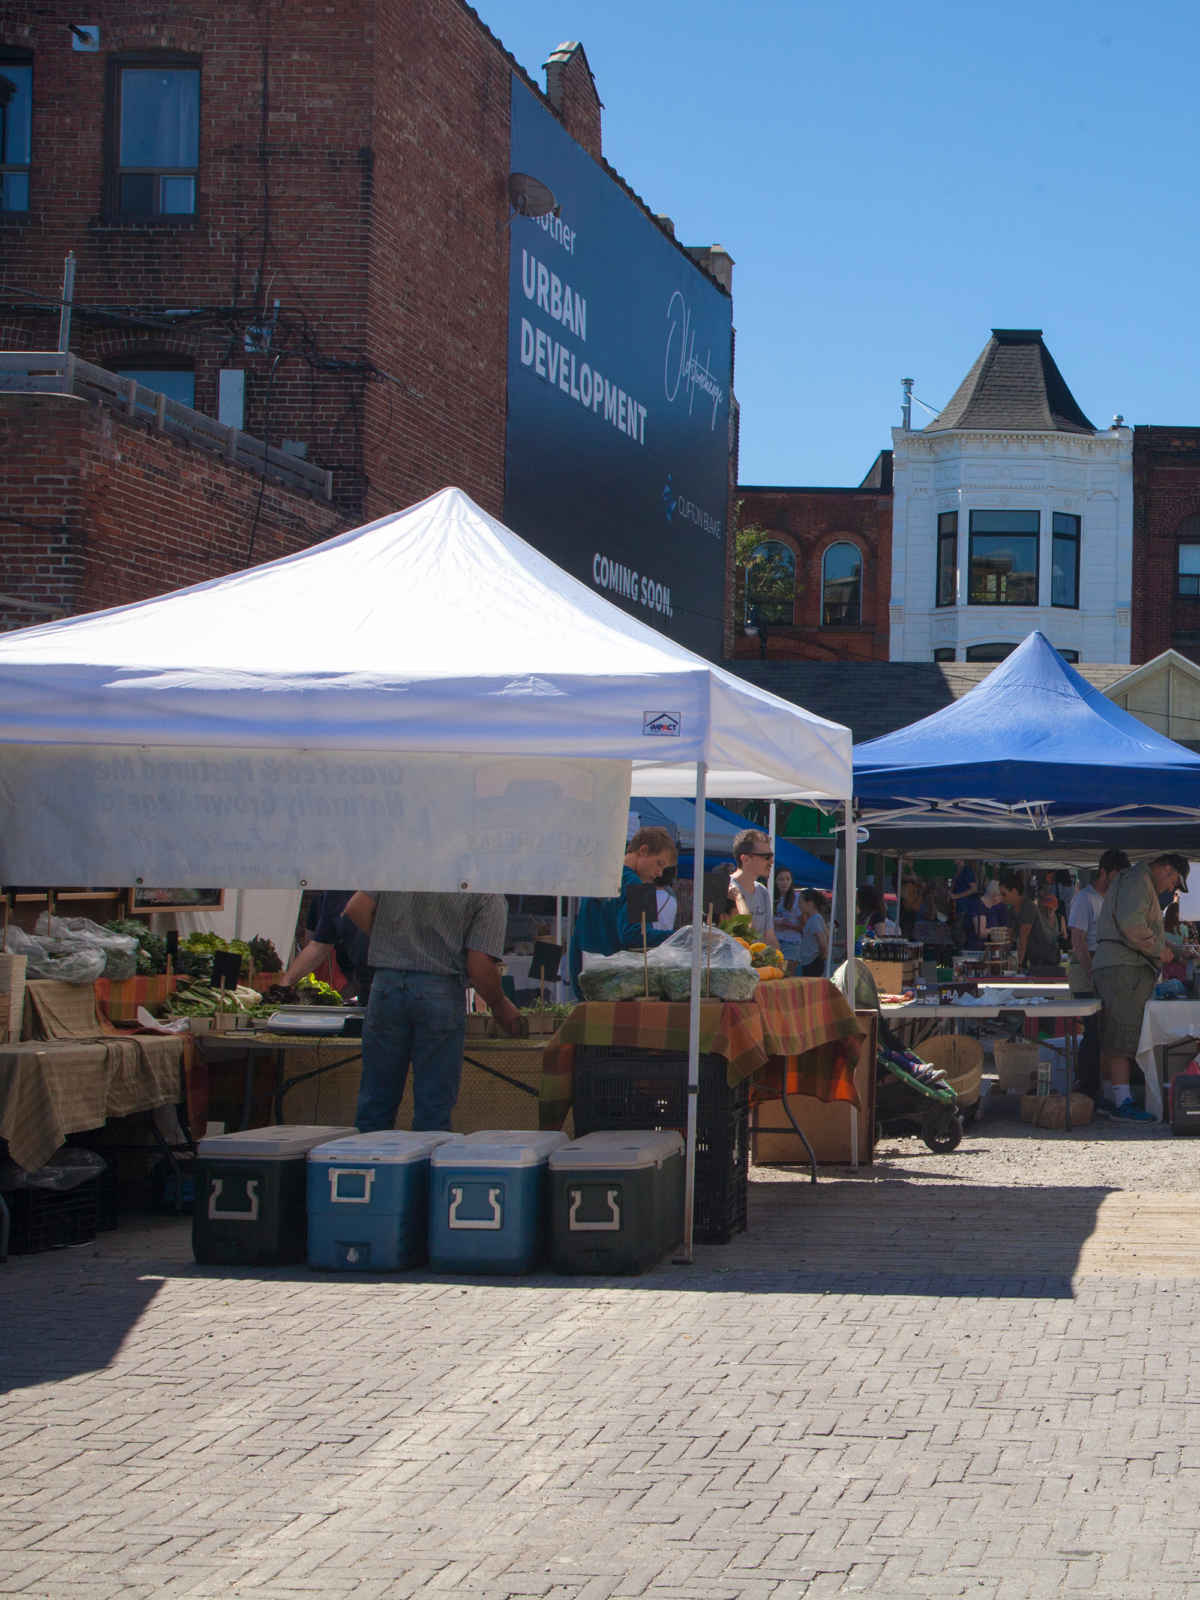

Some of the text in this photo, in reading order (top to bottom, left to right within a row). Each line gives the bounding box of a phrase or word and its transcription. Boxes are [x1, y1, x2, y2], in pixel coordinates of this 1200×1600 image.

[527, 210, 576, 256] other
[522, 248, 587, 342] URBAN
[520, 317, 648, 446] DEVELOPMENT
[593, 552, 639, 602] COMING
